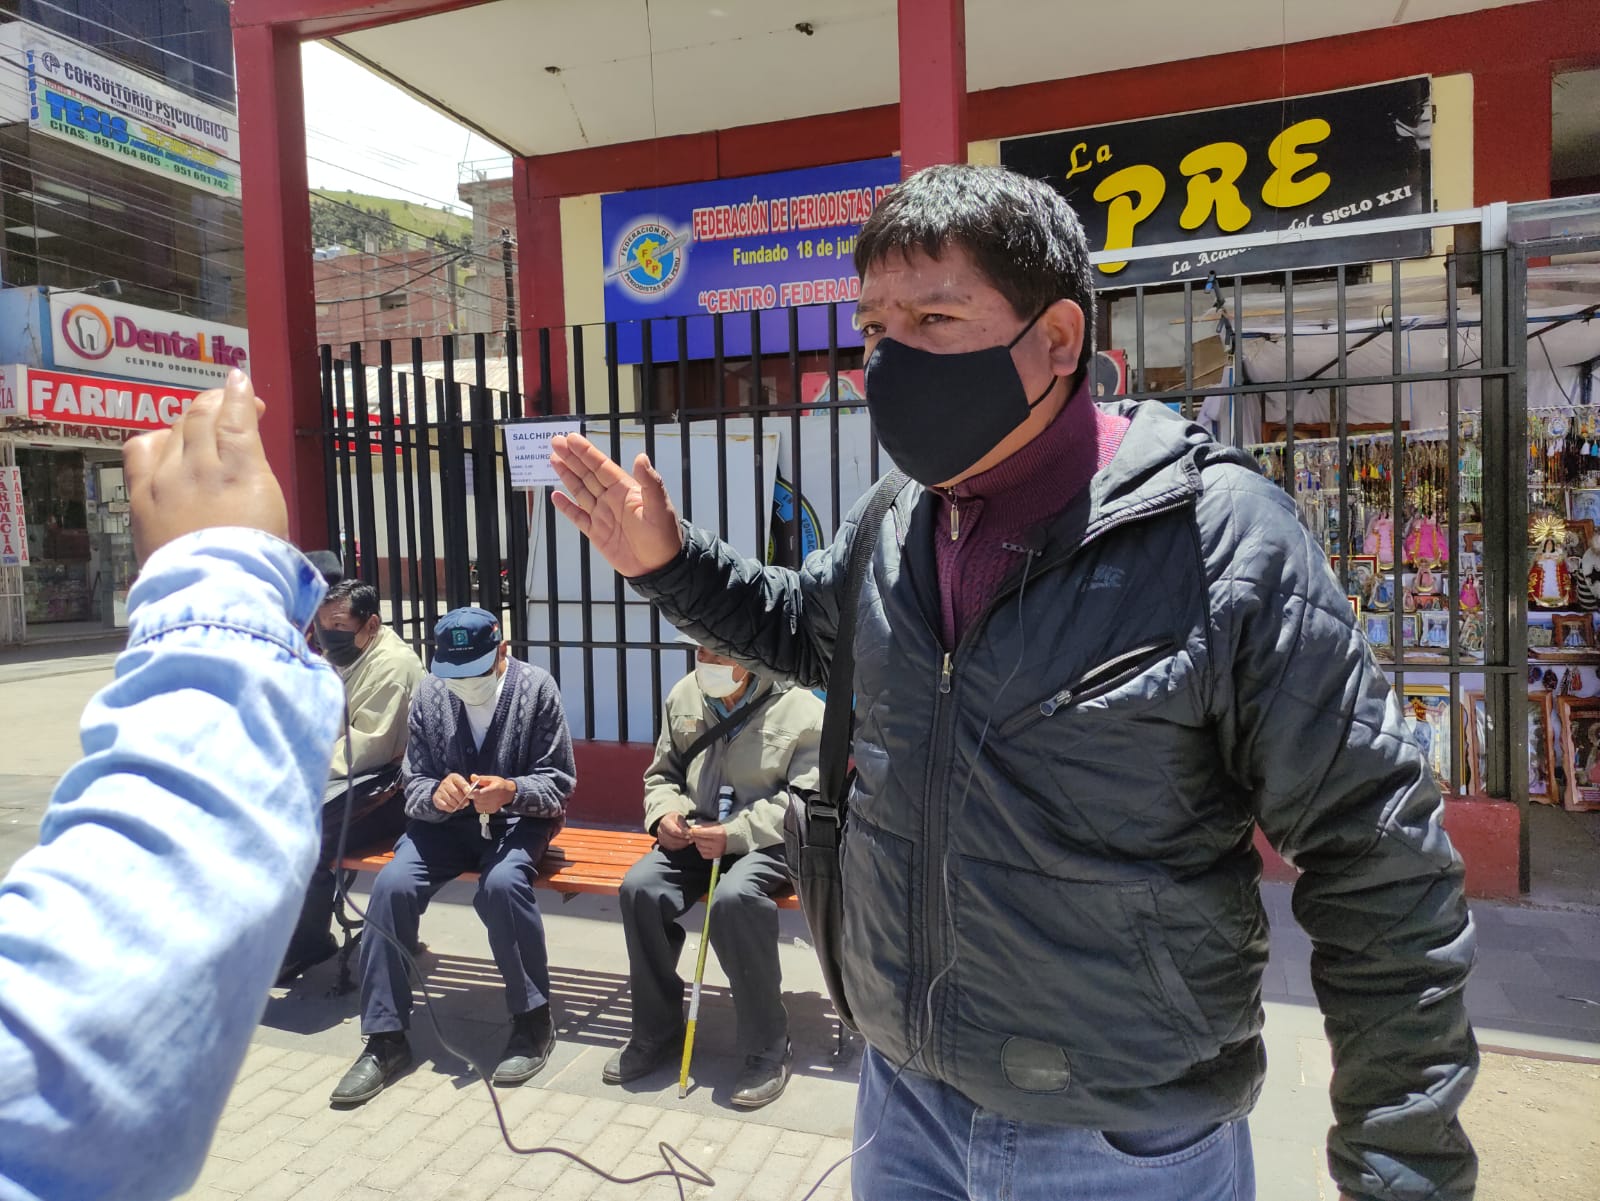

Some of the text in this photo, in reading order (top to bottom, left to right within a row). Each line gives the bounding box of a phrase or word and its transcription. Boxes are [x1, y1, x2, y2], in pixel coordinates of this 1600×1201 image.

[45, 90, 129, 144] TESIS
[64, 62, 153, 113] CONSULTORIO
[155, 99, 228, 142] PSICOLÓGICO
[50, 119, 89, 141] CITAS:
[1065, 142, 1113, 179] La
[692, 195, 769, 241] FEDERACIÓN
[771, 200, 789, 233] DE
[790, 186, 873, 232] PERIODISTAS
[1093, 118, 1331, 274] PRE
[1321, 199, 1373, 225] SIGLO
[1375, 185, 1413, 207] XXI
[732, 235, 858, 266] Fundado 18 de juli
[780, 276, 861, 308] FEDERAD
[114, 316, 248, 369] DentaLike
[125, 356, 228, 379] CENTRO ODONTOLOGI
[31, 379, 193, 425] FARMAC
[512, 431, 574, 440] SALCHIPAPA
[0, 470, 15, 555] FARMACIA
[12, 470, 28, 561] FARMACIA
[803, 517, 816, 553] EDUCAC
